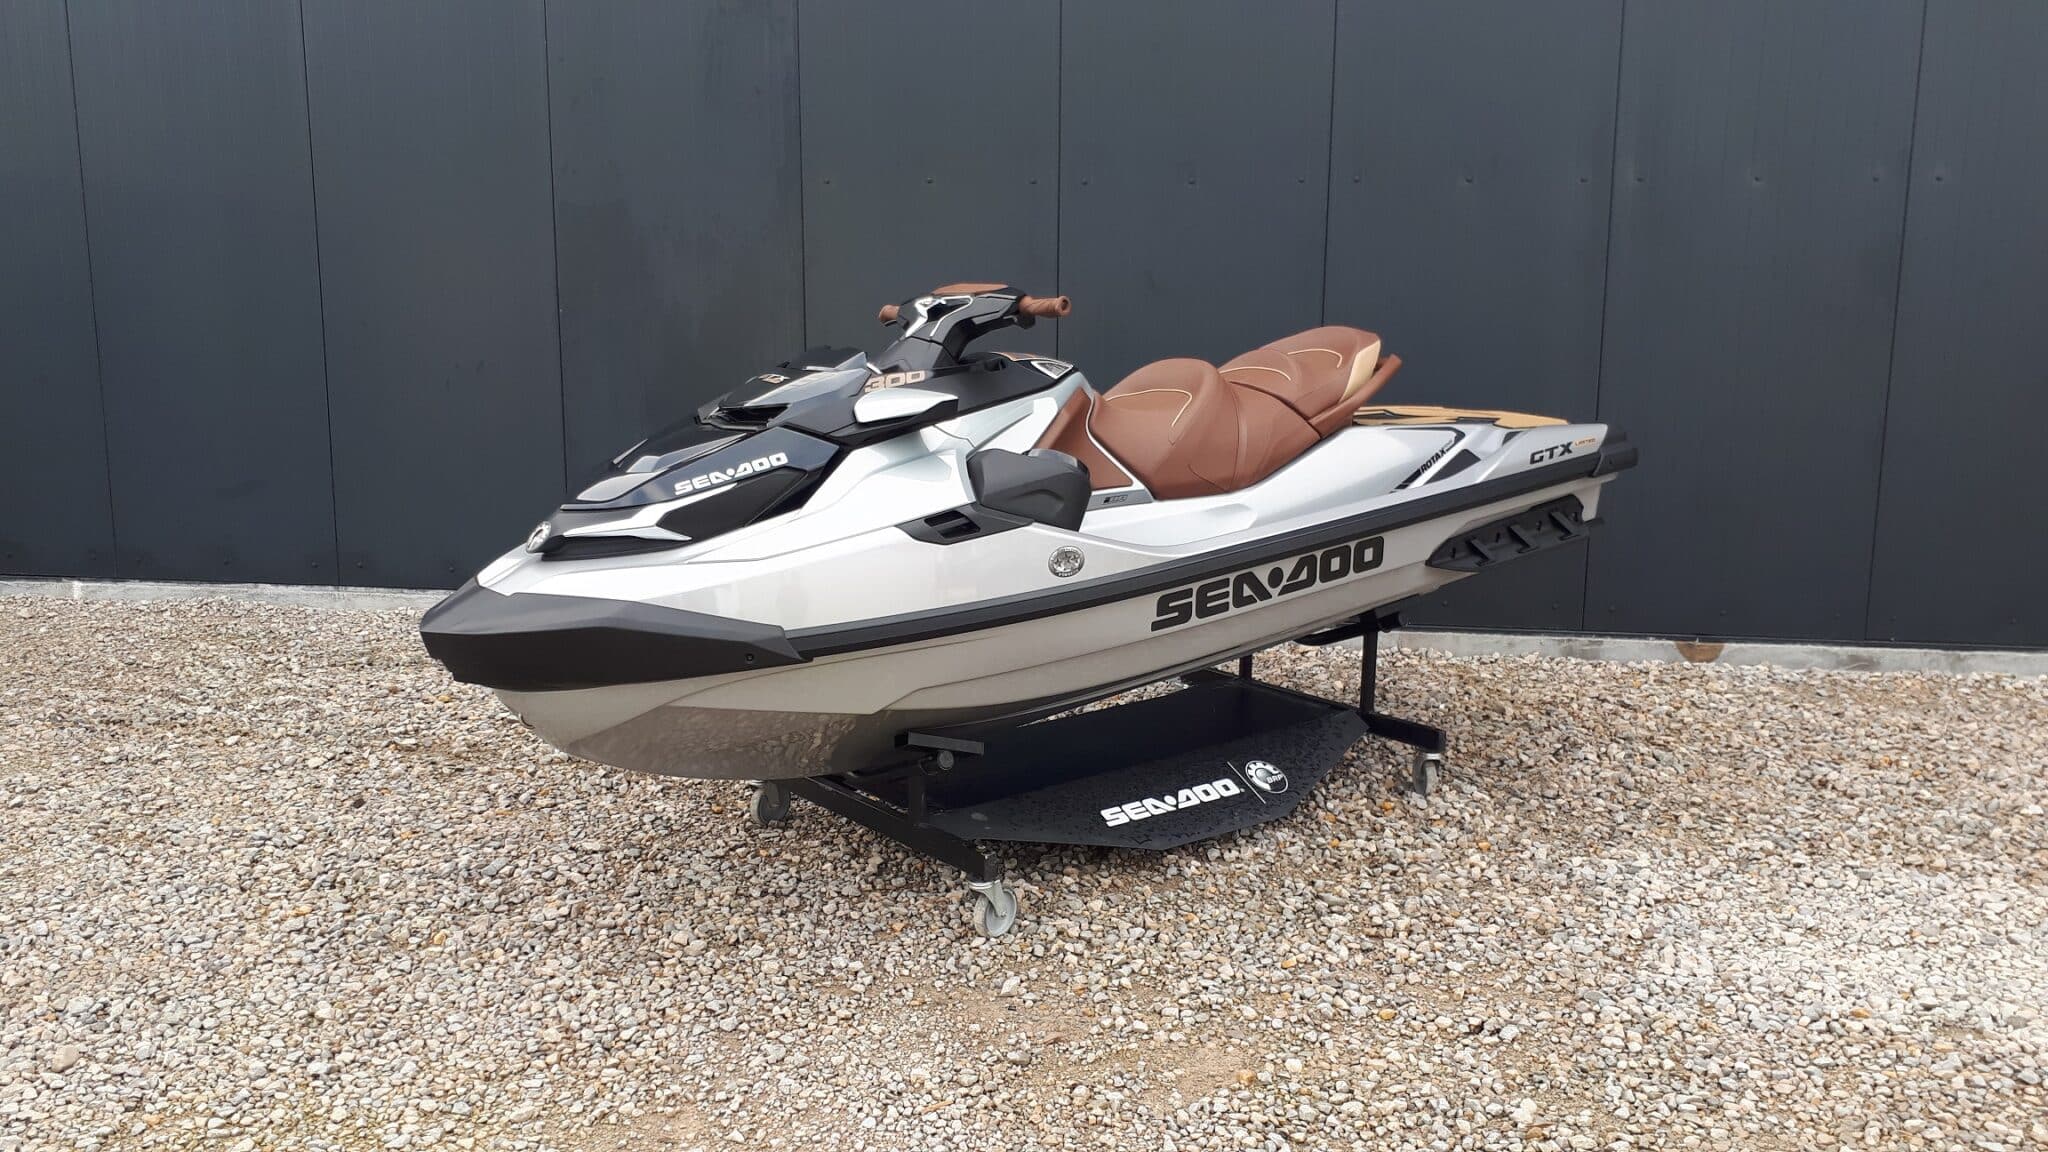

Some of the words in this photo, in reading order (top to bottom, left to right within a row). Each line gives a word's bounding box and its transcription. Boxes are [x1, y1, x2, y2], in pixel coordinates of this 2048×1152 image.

[864, 370, 926, 393] 300
[1420, 448, 1446, 474] ROTAX
[1529, 441, 1573, 465] GTX
